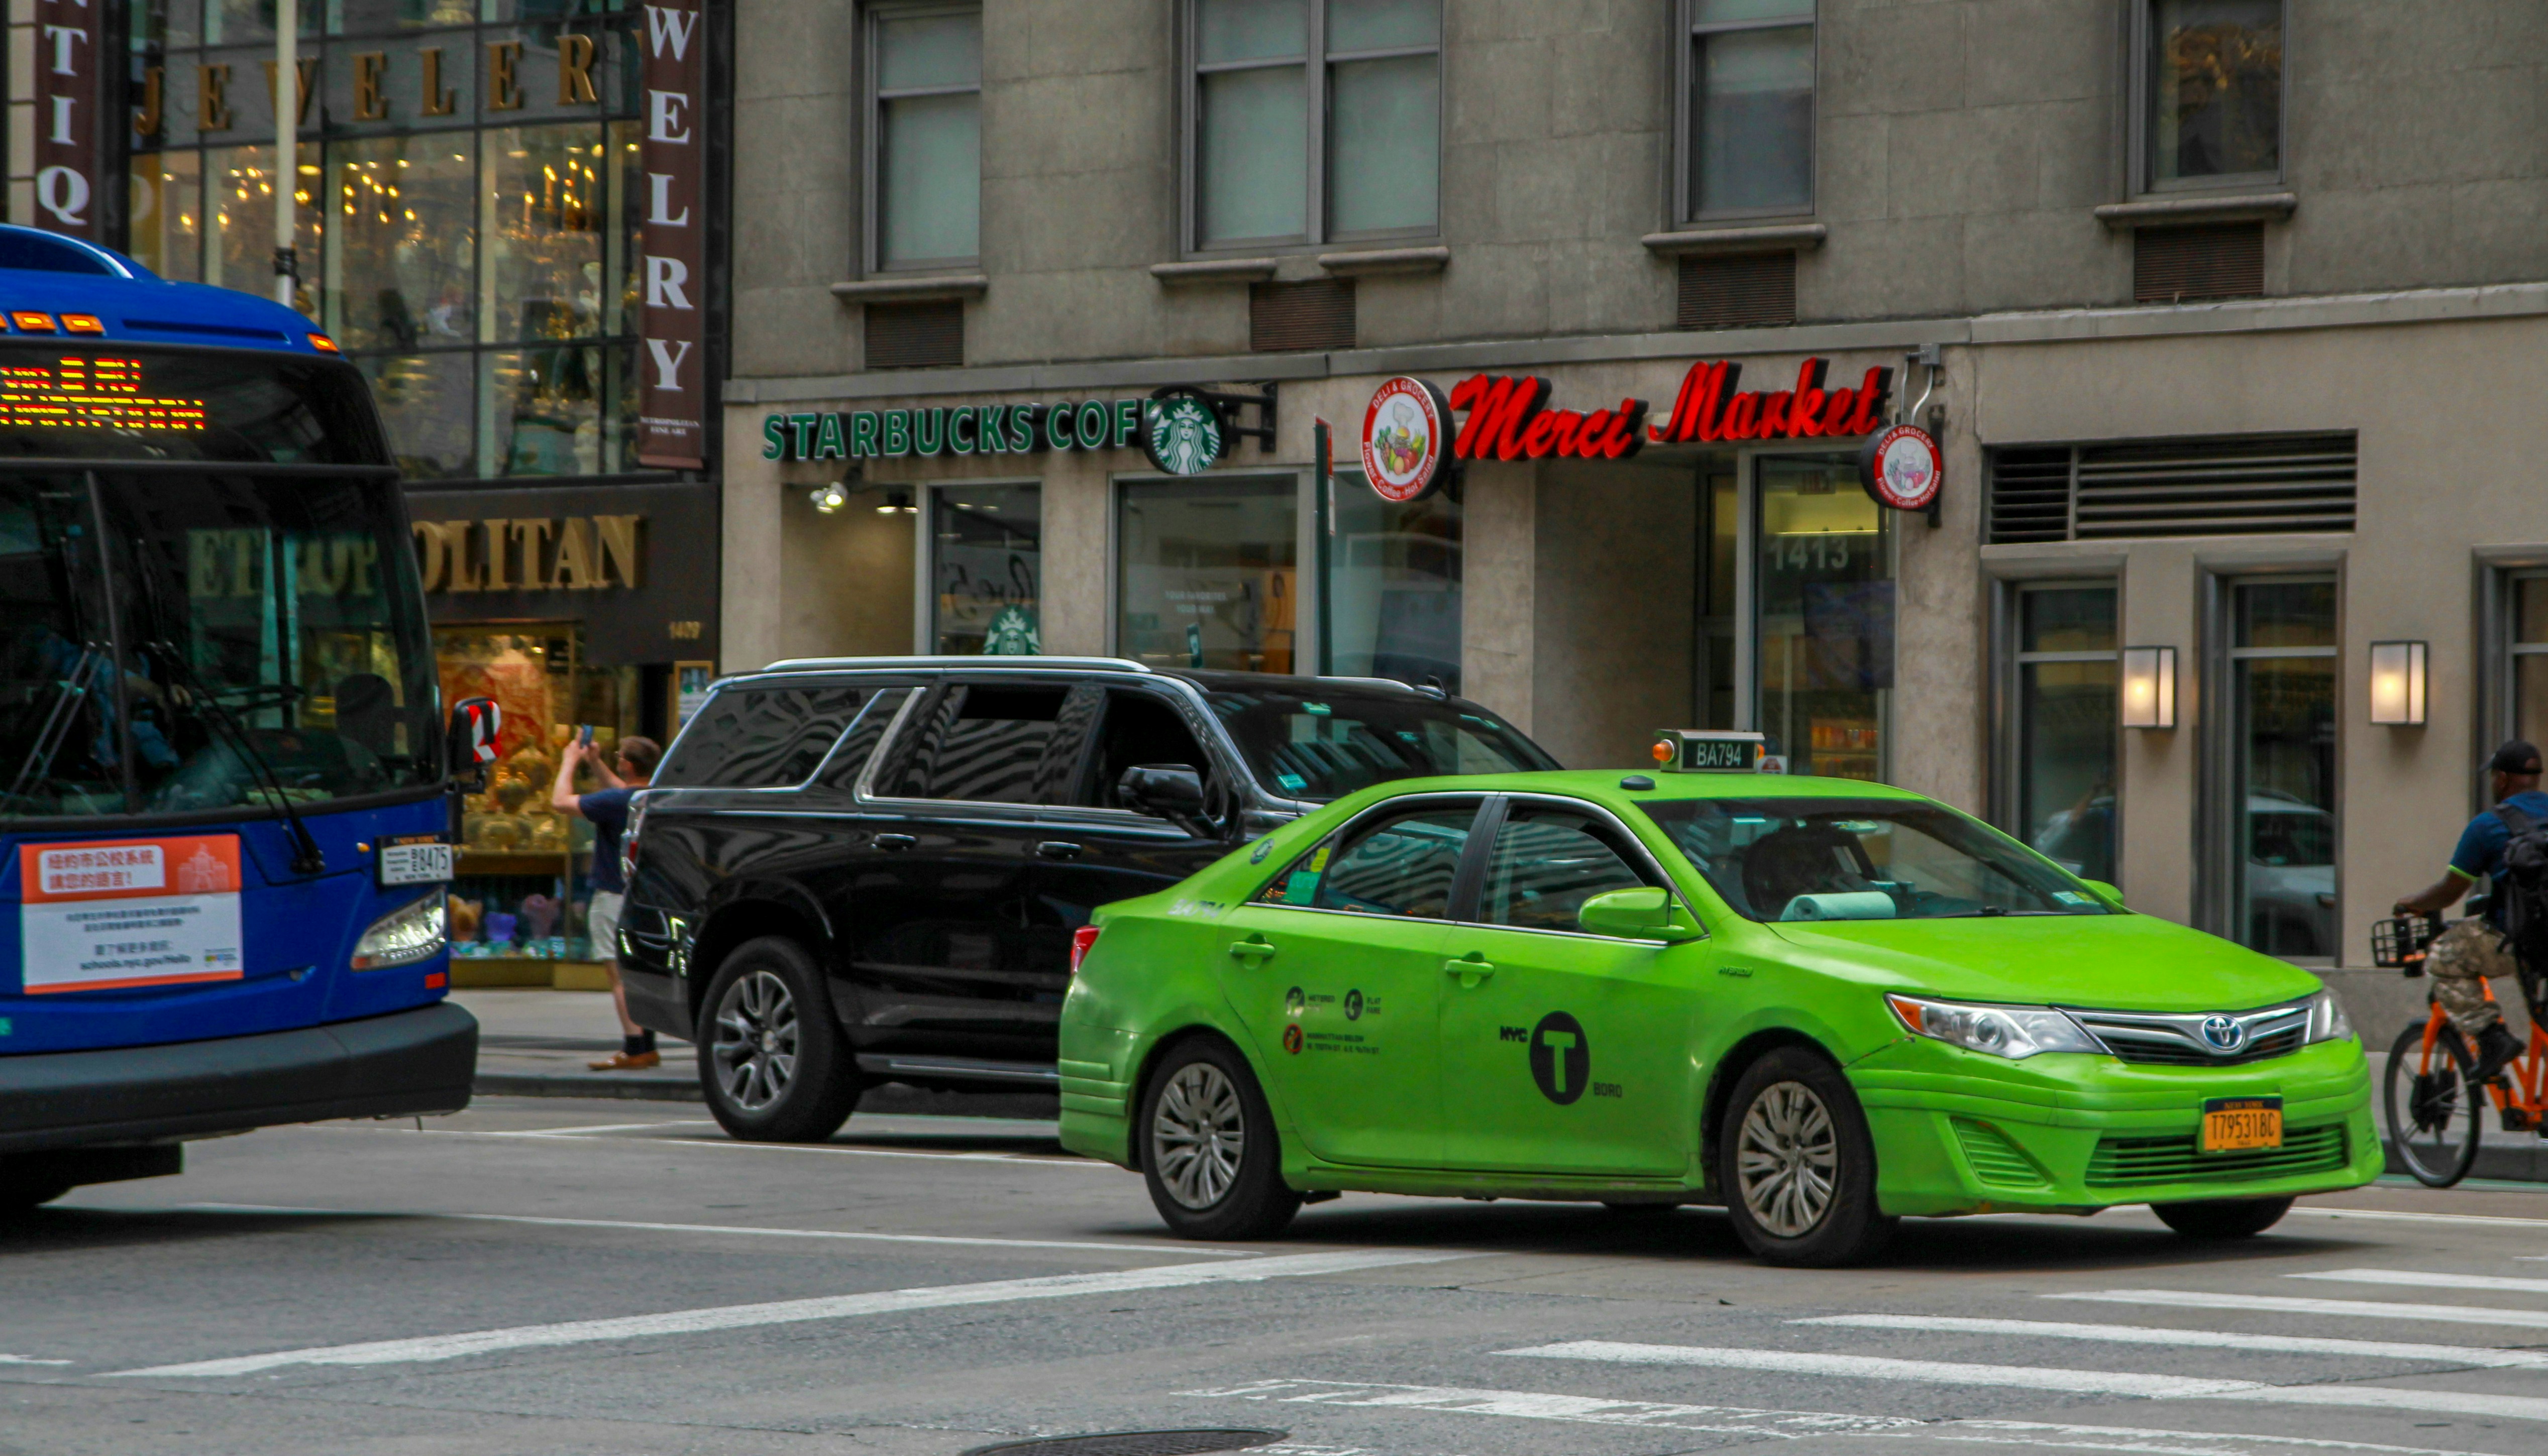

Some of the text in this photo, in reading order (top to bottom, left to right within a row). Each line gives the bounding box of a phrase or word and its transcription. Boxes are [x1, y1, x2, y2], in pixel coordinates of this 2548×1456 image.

[1372, 380, 1435, 418] DELI & GROCERY
[1450, 357, 1880, 461] Merci Market
[763, 397, 1159, 461] STARBUCKS COF
[1878, 435, 1892, 455] DELI
[1899, 427, 1934, 449] GROCERY
[1363, 441, 1434, 498] Flower Coffee Hot Salad
[1878, 470, 1941, 506] Flower Coffee Hot Salad
[1768, 535, 1849, 570] 1413
[1696, 742, 1742, 767] BA794
[1500, 1026, 1528, 1043] NYC
[1543, 1030, 1576, 1093] T
[1594, 1082, 1623, 1098] BORO
[2212, 1112, 2275, 1139] T795318C
